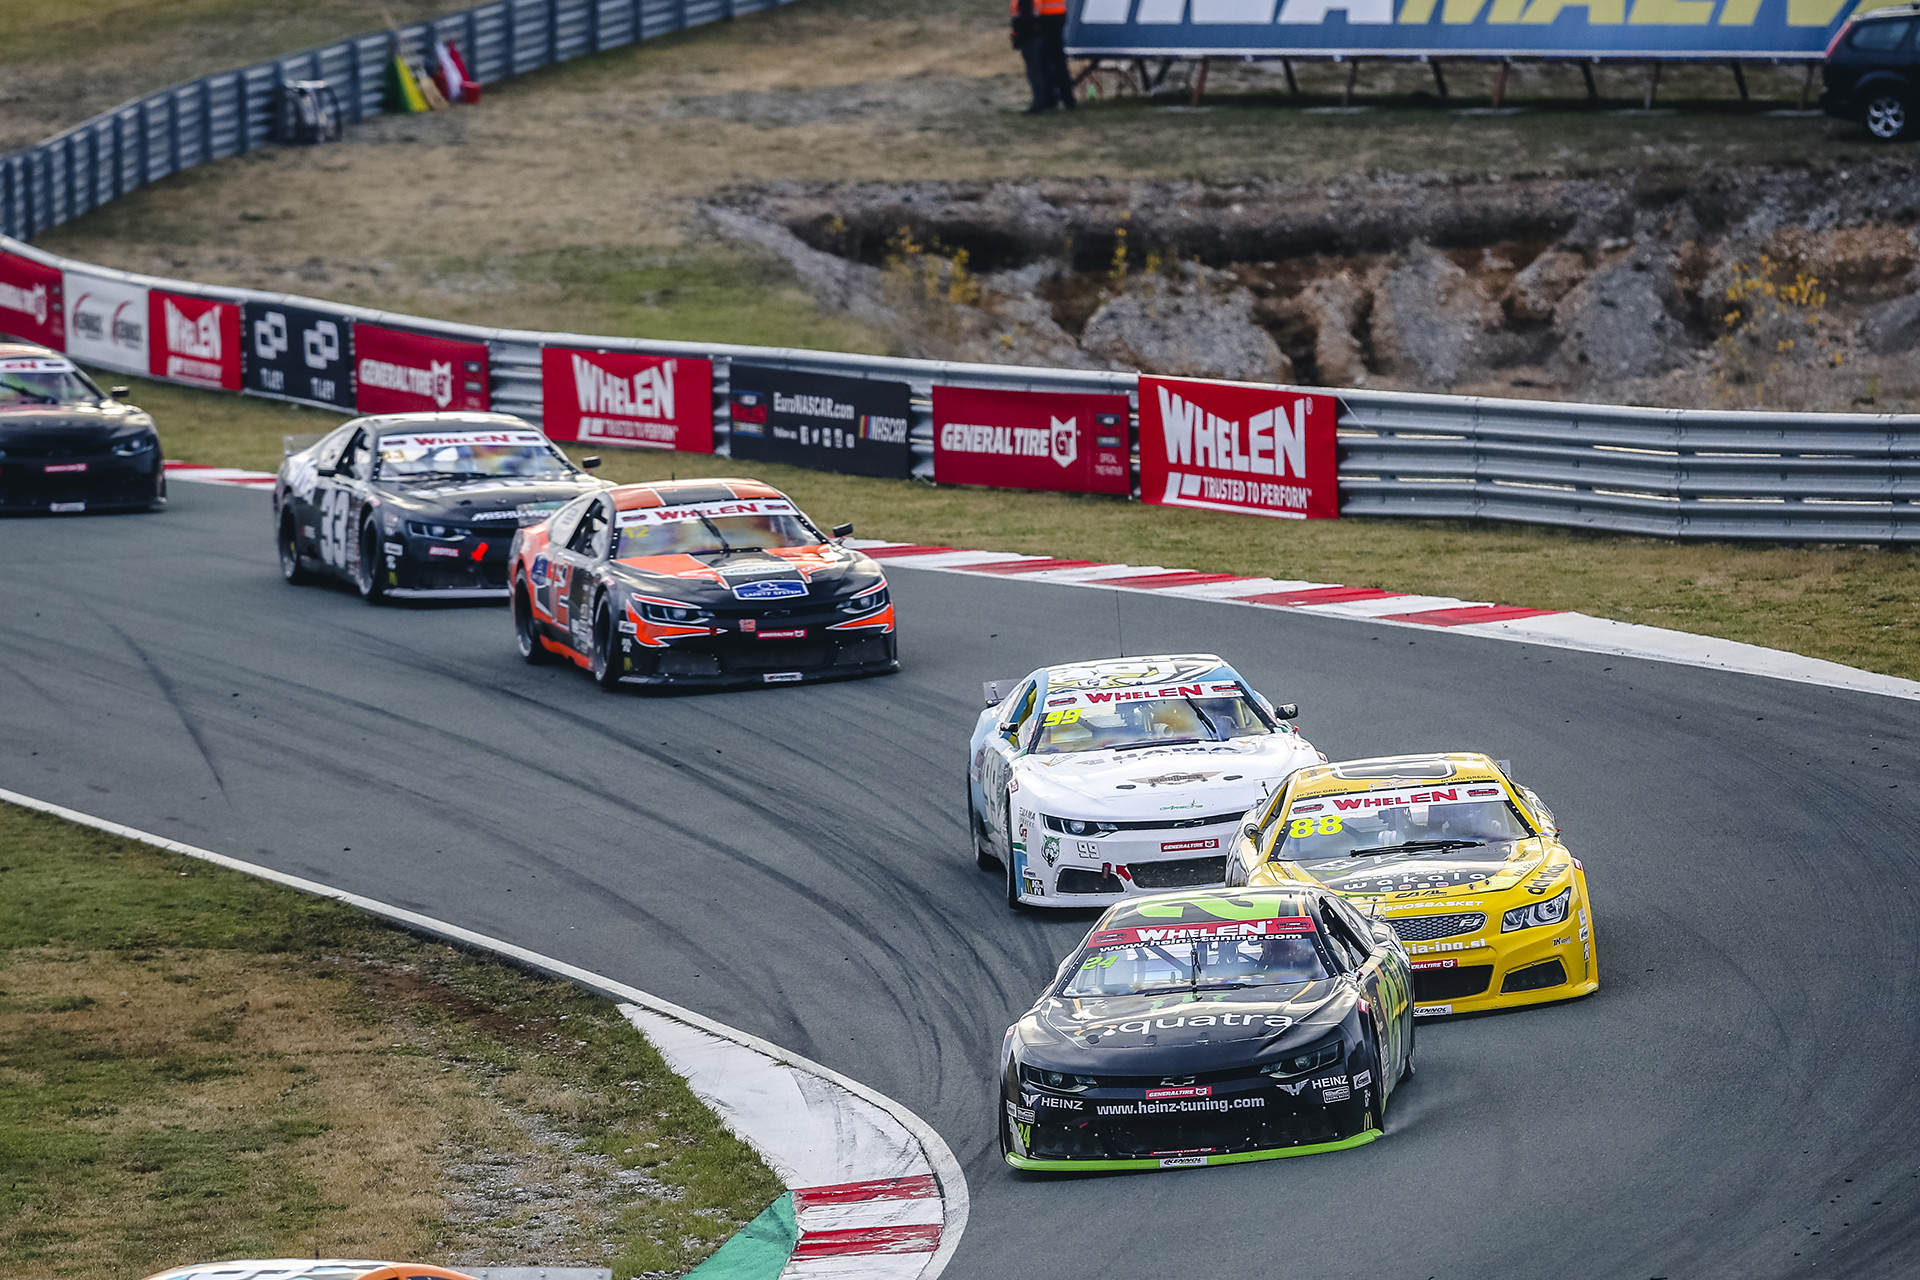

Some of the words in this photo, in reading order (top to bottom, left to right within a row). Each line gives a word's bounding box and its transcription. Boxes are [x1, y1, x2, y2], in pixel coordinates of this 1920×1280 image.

[571, 353, 675, 420] WHELEN
[772, 391, 855, 420] EuroNASCAR.com
[870, 415, 907, 444] NASCAR
[1157, 384, 1306, 479] WHELEN
[414, 434, 510, 446] WHELEN
[1203, 476, 1245, 502] TRUSTED
[1246, 481, 1259, 504] TO
[655, 503, 759, 520] WHELEN
[622, 526, 650, 539] 12
[1086, 684, 1203, 704] WHELEN
[1043, 708, 1083, 727] 99
[1333, 788, 1458, 811] WHELEN
[1289, 815, 1343, 838] 88
[1077, 841, 1100, 860] 99
[1383, 900, 1485, 912] GROSBASKET
[1136, 921, 1268, 942] WHELEN
[1081, 955, 1119, 970] 24
[1118, 1012, 1293, 1035] quatra
[1312, 1075, 1348, 1089] HEINZ
[1041, 1096, 1083, 1110] HEINZ
[1096, 1097, 1265, 1116] www.heinz-tuning.com
[1018, 1123, 1031, 1148] 24
